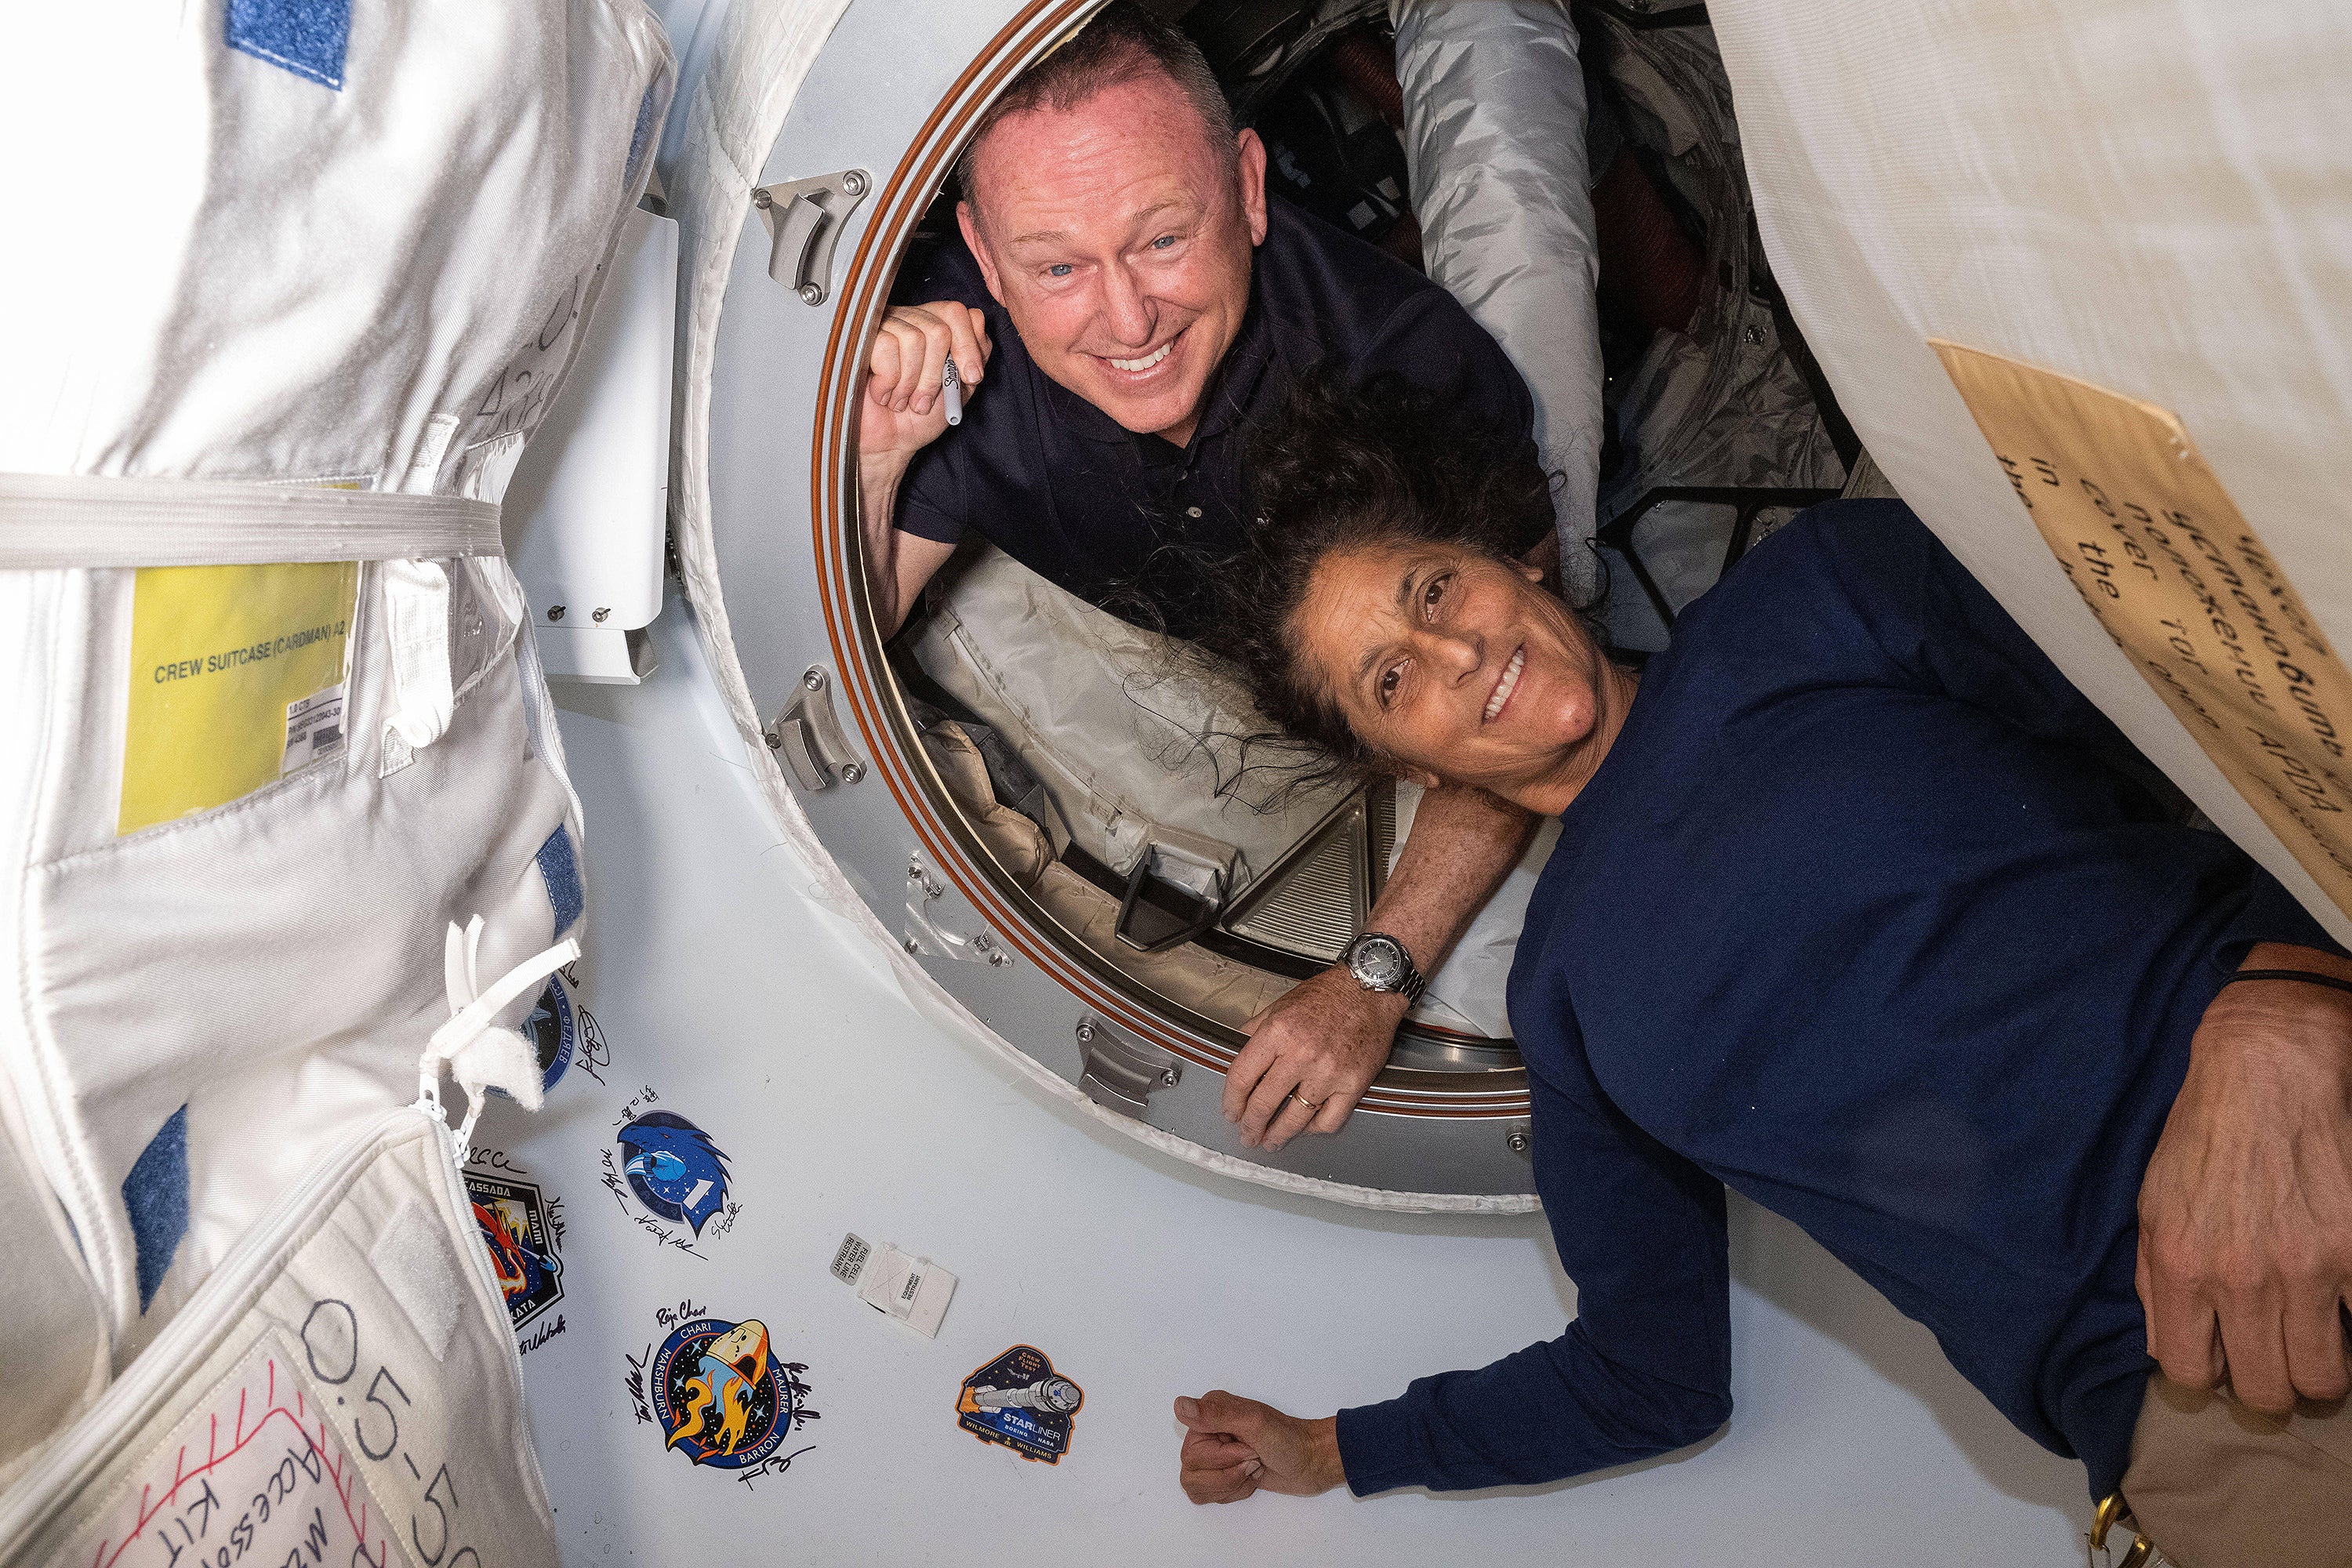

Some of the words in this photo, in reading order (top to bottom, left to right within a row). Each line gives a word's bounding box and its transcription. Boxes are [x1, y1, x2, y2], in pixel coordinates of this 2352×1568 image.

[2030, 456, 2060, 487] in
[2078, 541, 2120, 600] the
[2079, 477, 2158, 581] cover
[154, 658, 203, 684] CREW
[207, 641, 271, 673] SUITCASE
[273, 626, 332, 657] (CARDMAN)
[332, 620, 346, 637] A2
[559, 1014, 573, 1065] ФЕДЯЕВ
[528, 1209, 544, 1245] MANN
[833, 1236, 855, 1272] RESTRAINT
[847, 1240, 862, 1263] WATER
[858, 1247, 869, 1264] FUEL
[840, 1261, 852, 1279] LINE
[848, 1264, 861, 1280] CELL
[901, 1272, 916, 1300] EQUIPMENT
[906, 1275, 921, 1301] RESTRAINT
[510, 1300, 537, 1323] KATA
[680, 1322, 712, 1340] CHARI
[1018, 1356, 1041, 1370] FLIGHT
[1021, 1363, 1037, 1373] TEST
[1022, 1352, 1041, 1363] CREW
[654, 1347, 672, 1420] MARSHBURN
[772, 1368, 790, 1414] MAURER
[965, 1421, 1000, 1439] WILMORE
[1017, 1441, 1053, 1459] WILLIAMS
[1003, 1413, 1062, 1441] STARLINER
[1004, 1425, 1029, 1438] BOEING
[1037, 1437, 1055, 1447] NASA
[739, 1432, 781, 1465] BARRON
[159, 1478, 220, 1568] KIT
